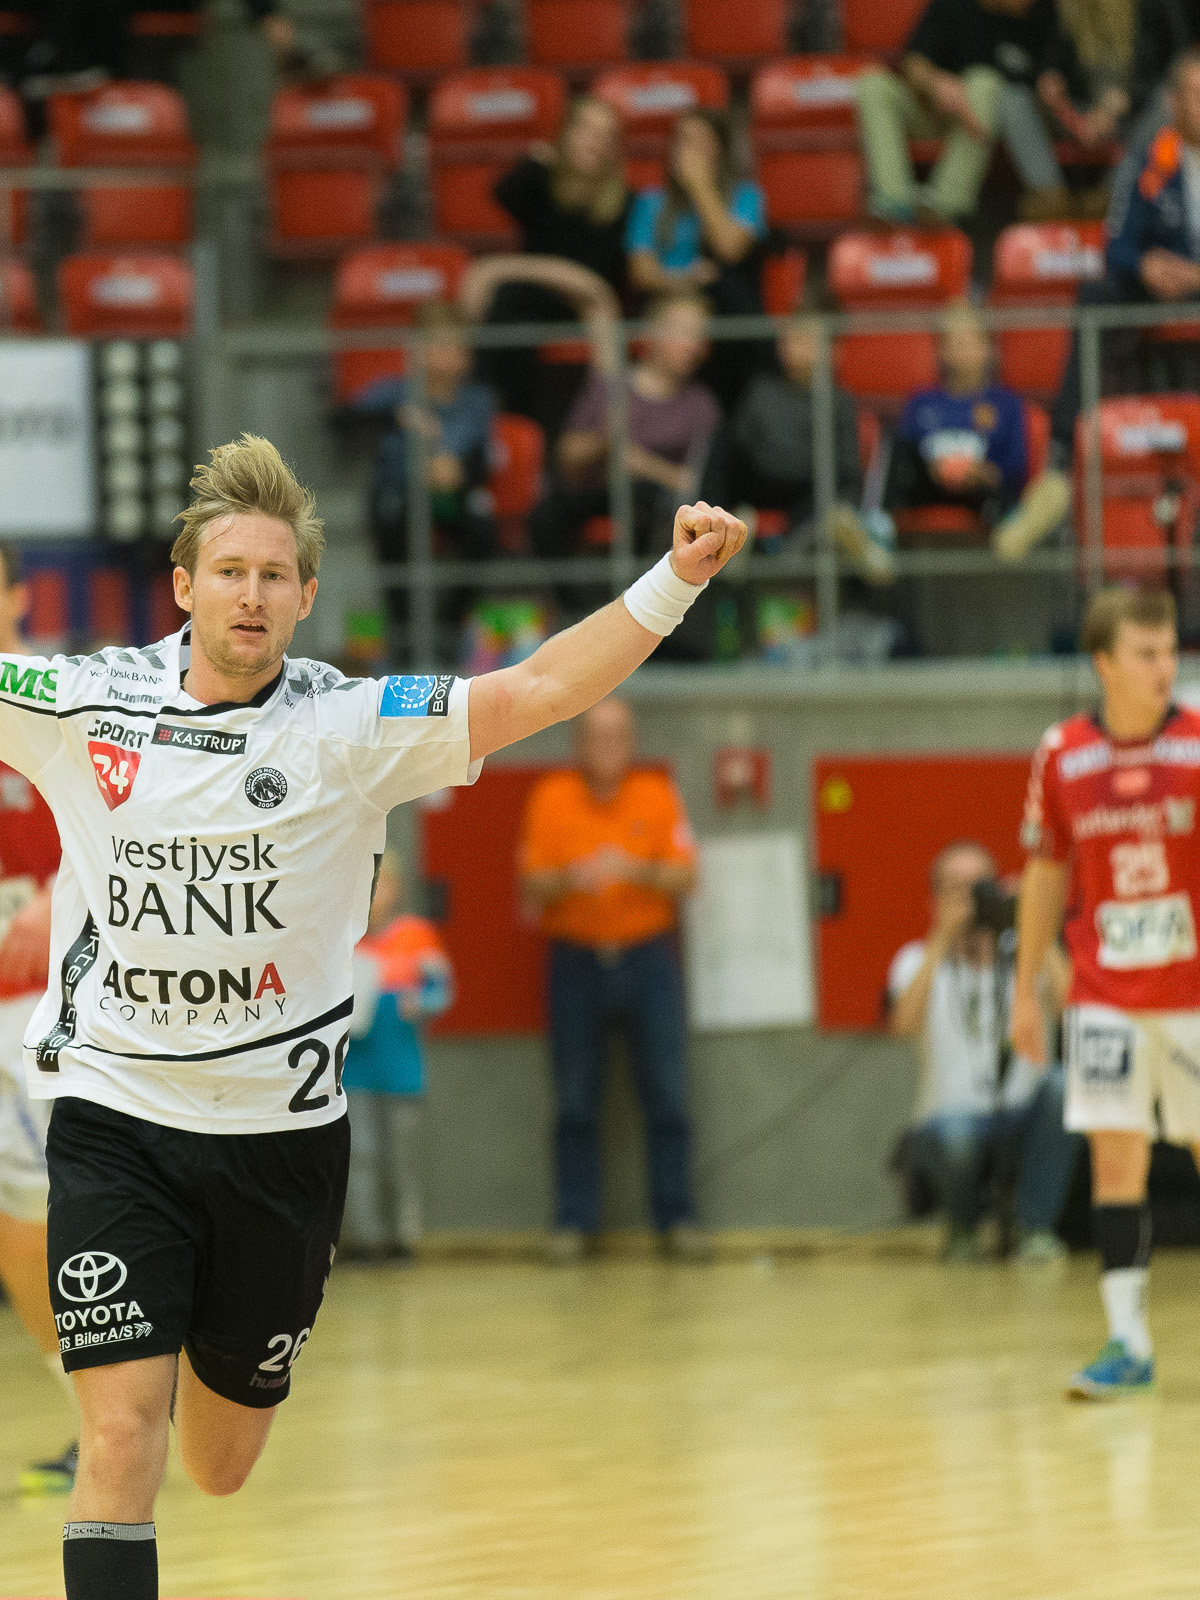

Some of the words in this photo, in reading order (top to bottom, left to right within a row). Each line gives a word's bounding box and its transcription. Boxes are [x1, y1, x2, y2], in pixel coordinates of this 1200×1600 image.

[87, 718, 150, 749] SPORT
[92, 753, 130, 796] 24
[111, 833, 279, 883] vestjysk
[108, 873, 288, 937] BANK
[102, 961, 287, 1005] ACTONA
[99, 997, 287, 1026] COMPANY
[54, 1300, 145, 1333] TOYOTA
[74, 1331, 107, 1347] Biler
[106, 1324, 134, 1341] A/S
